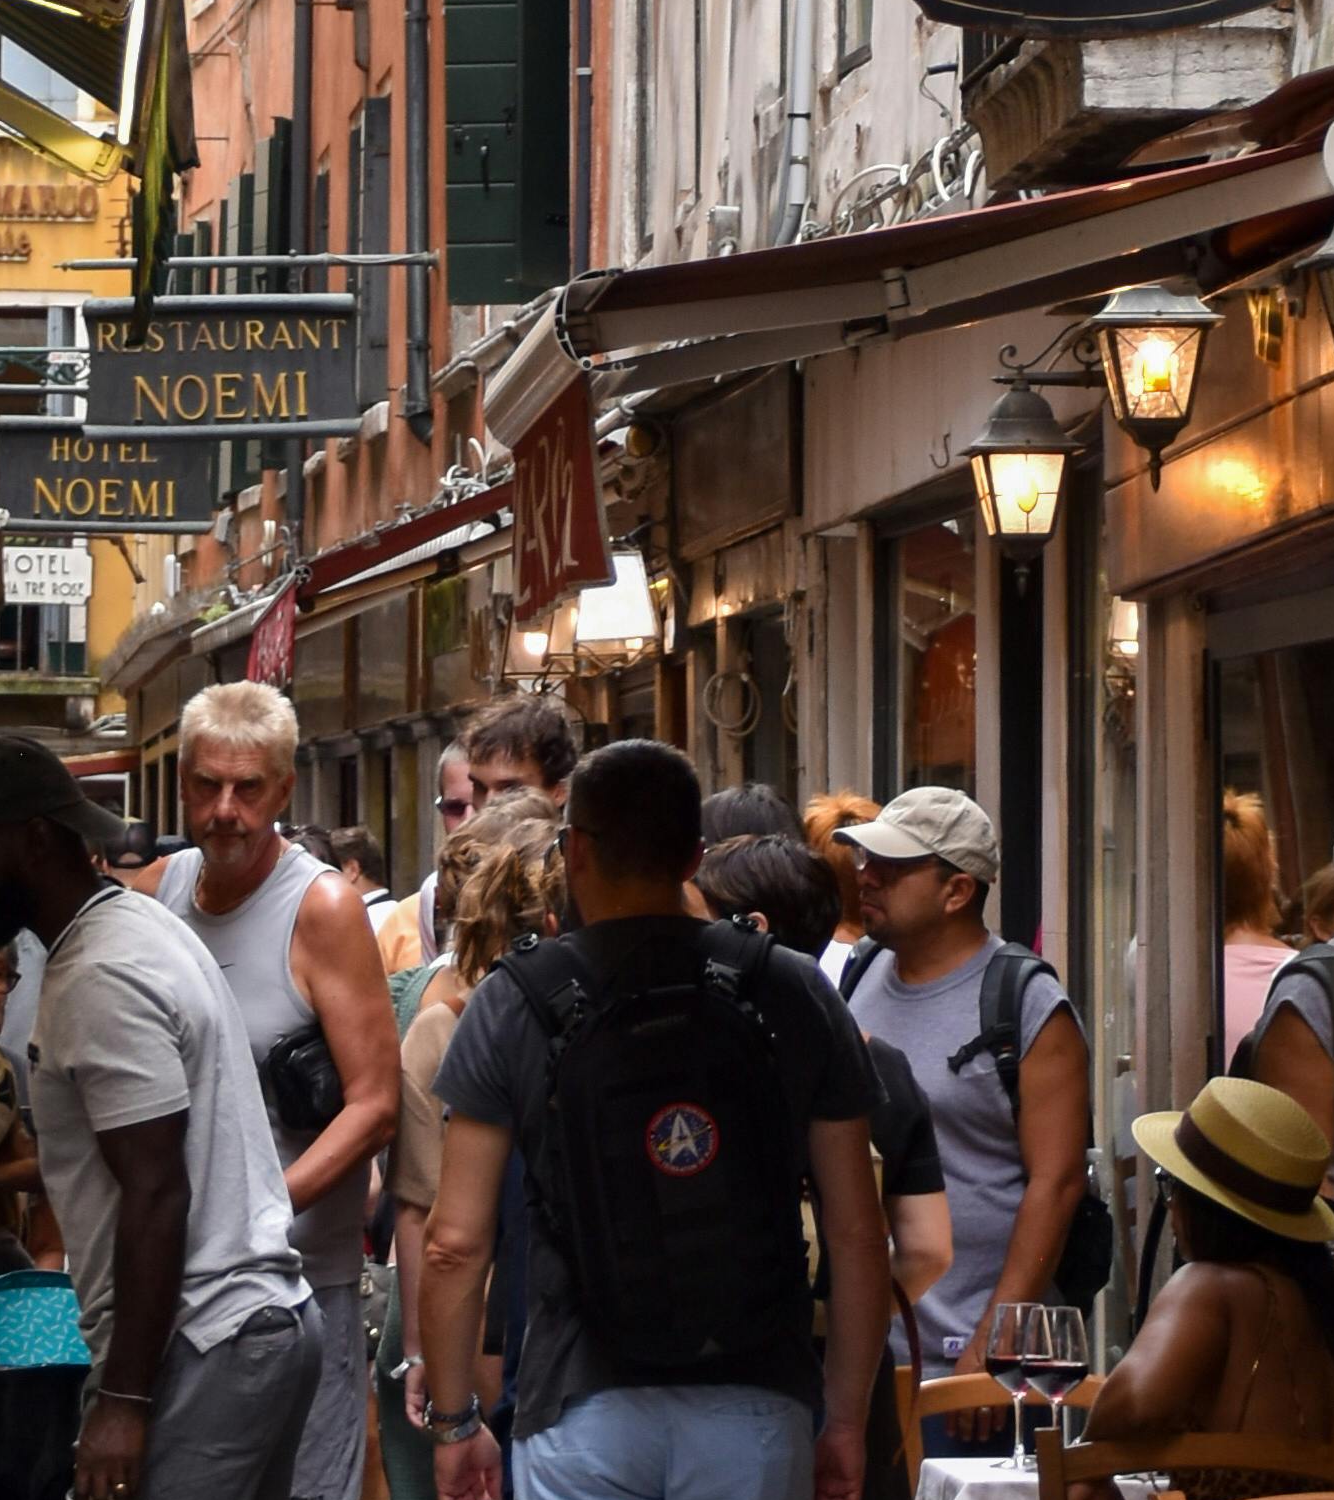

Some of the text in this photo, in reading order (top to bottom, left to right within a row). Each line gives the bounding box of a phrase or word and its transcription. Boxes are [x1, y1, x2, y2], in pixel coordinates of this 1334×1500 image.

[133, 371, 310, 422] NOEMI
[33, 477, 176, 517] NOEMI
[25, 581, 46, 596] TRE
[52, 582, 84, 597] ROSE
